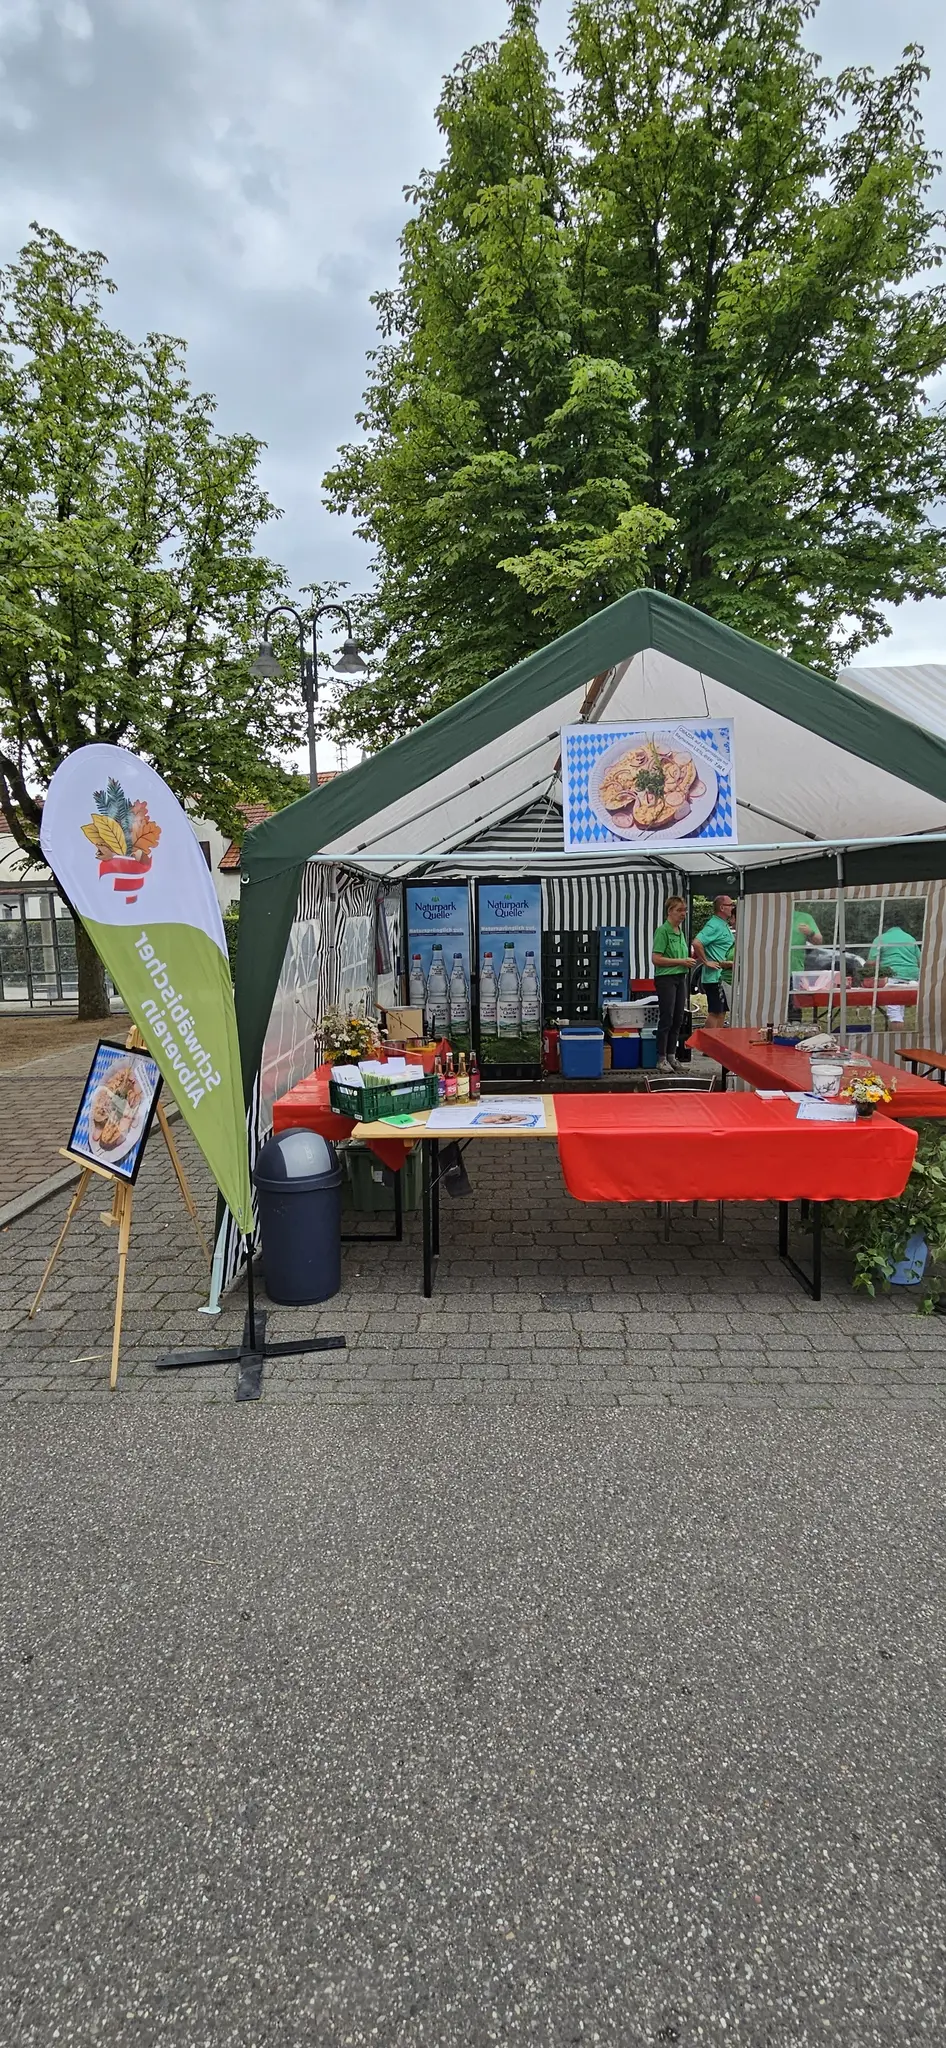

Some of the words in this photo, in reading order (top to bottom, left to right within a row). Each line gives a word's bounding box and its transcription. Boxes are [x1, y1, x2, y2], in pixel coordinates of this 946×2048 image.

[415, 901, 457, 912] Naturpark
[487, 900, 529, 910] Naturpark
[422, 910, 450, 920] Quelle
[494, 908, 522, 918] Quelle
